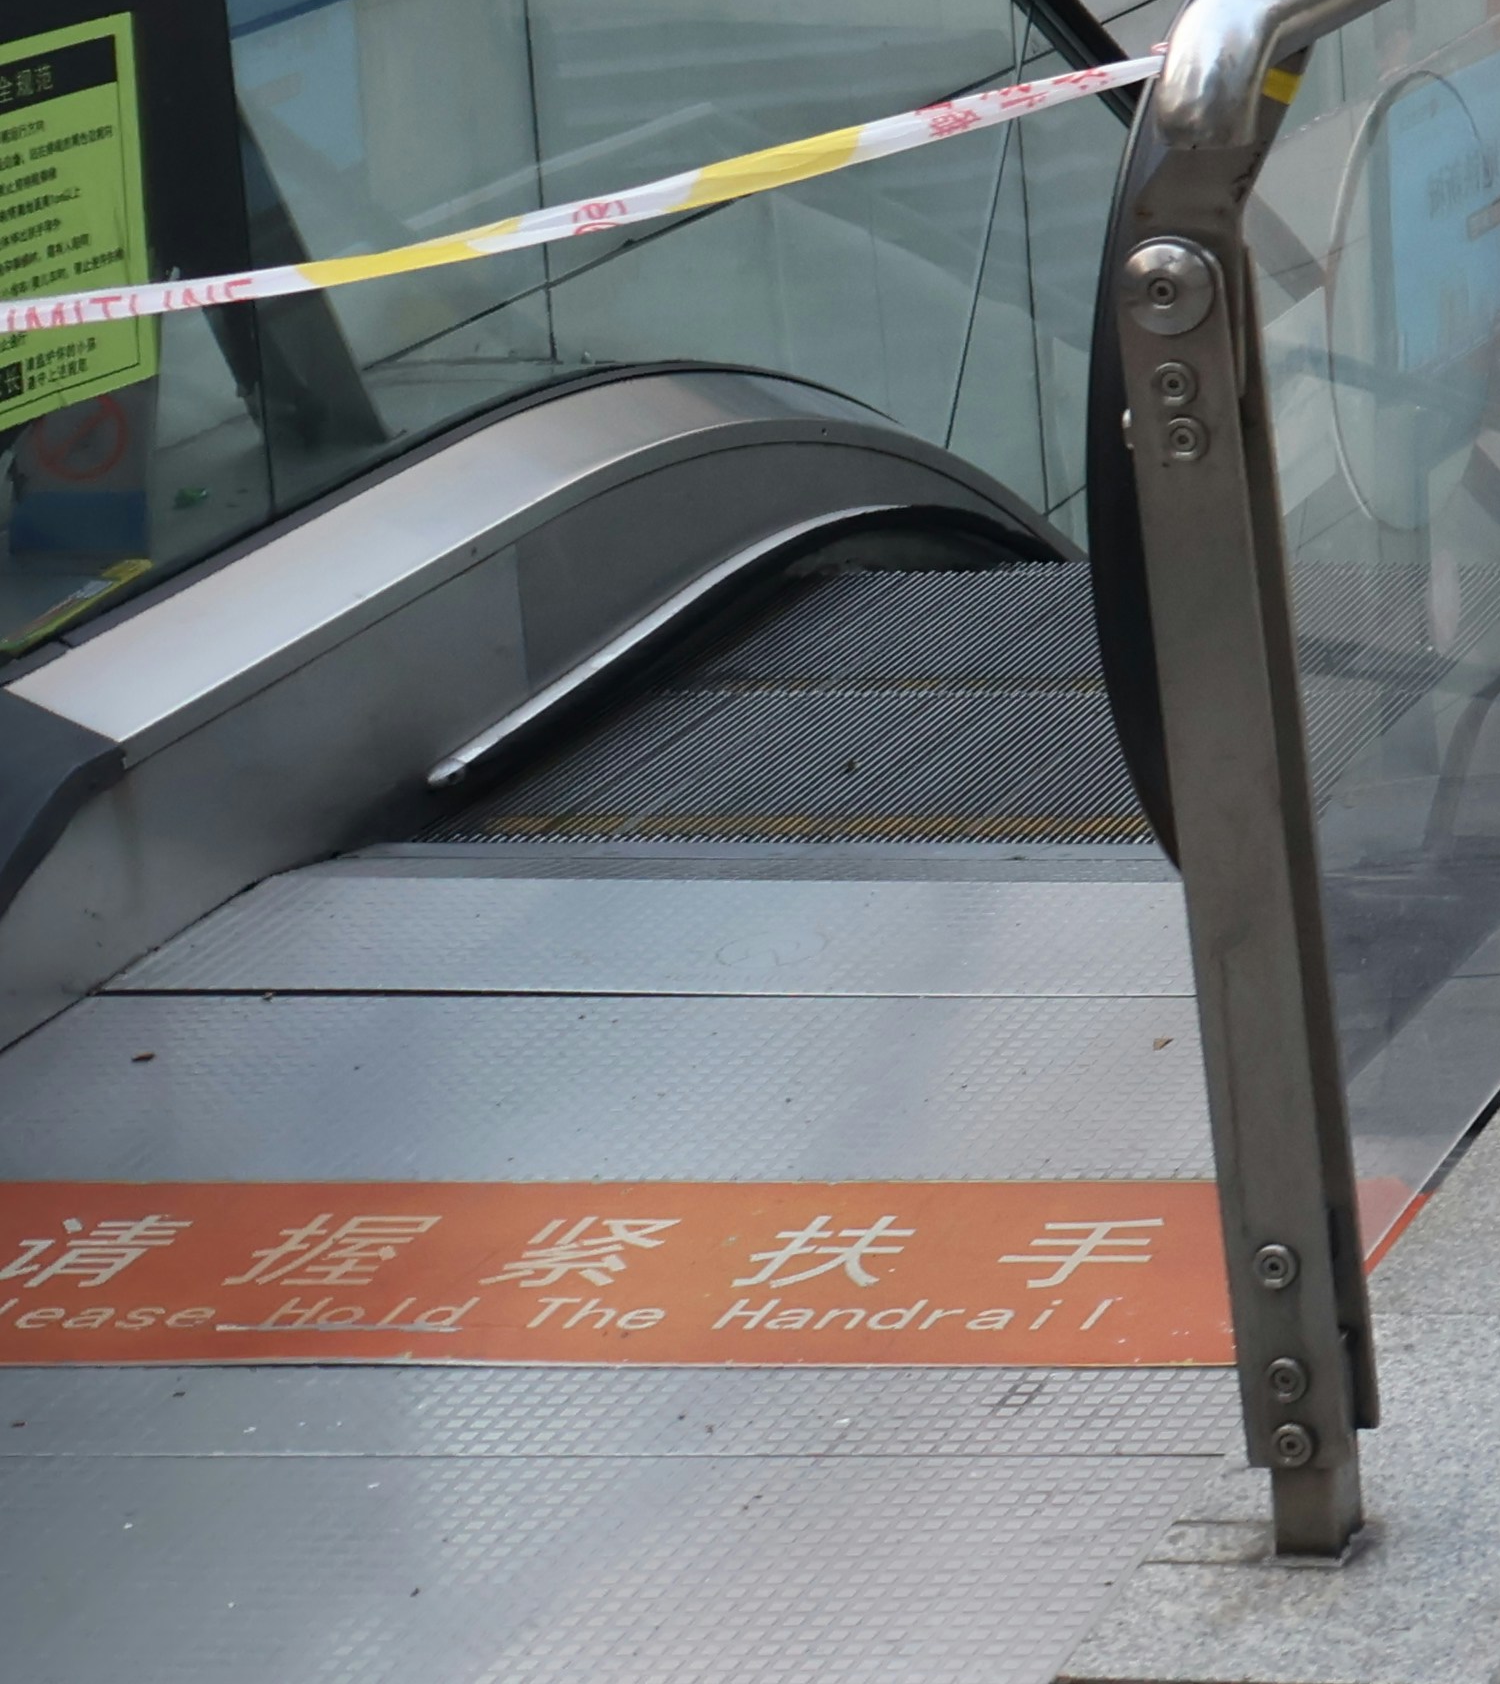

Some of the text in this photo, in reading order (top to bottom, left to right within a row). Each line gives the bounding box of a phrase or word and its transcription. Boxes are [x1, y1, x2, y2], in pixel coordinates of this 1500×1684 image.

[0, 1213, 1165, 1290] 请握紧扶手
[256, 1296, 481, 1330] Hold
[525, 1297, 667, 1331] The
[711, 1297, 1119, 1332] Handrail
